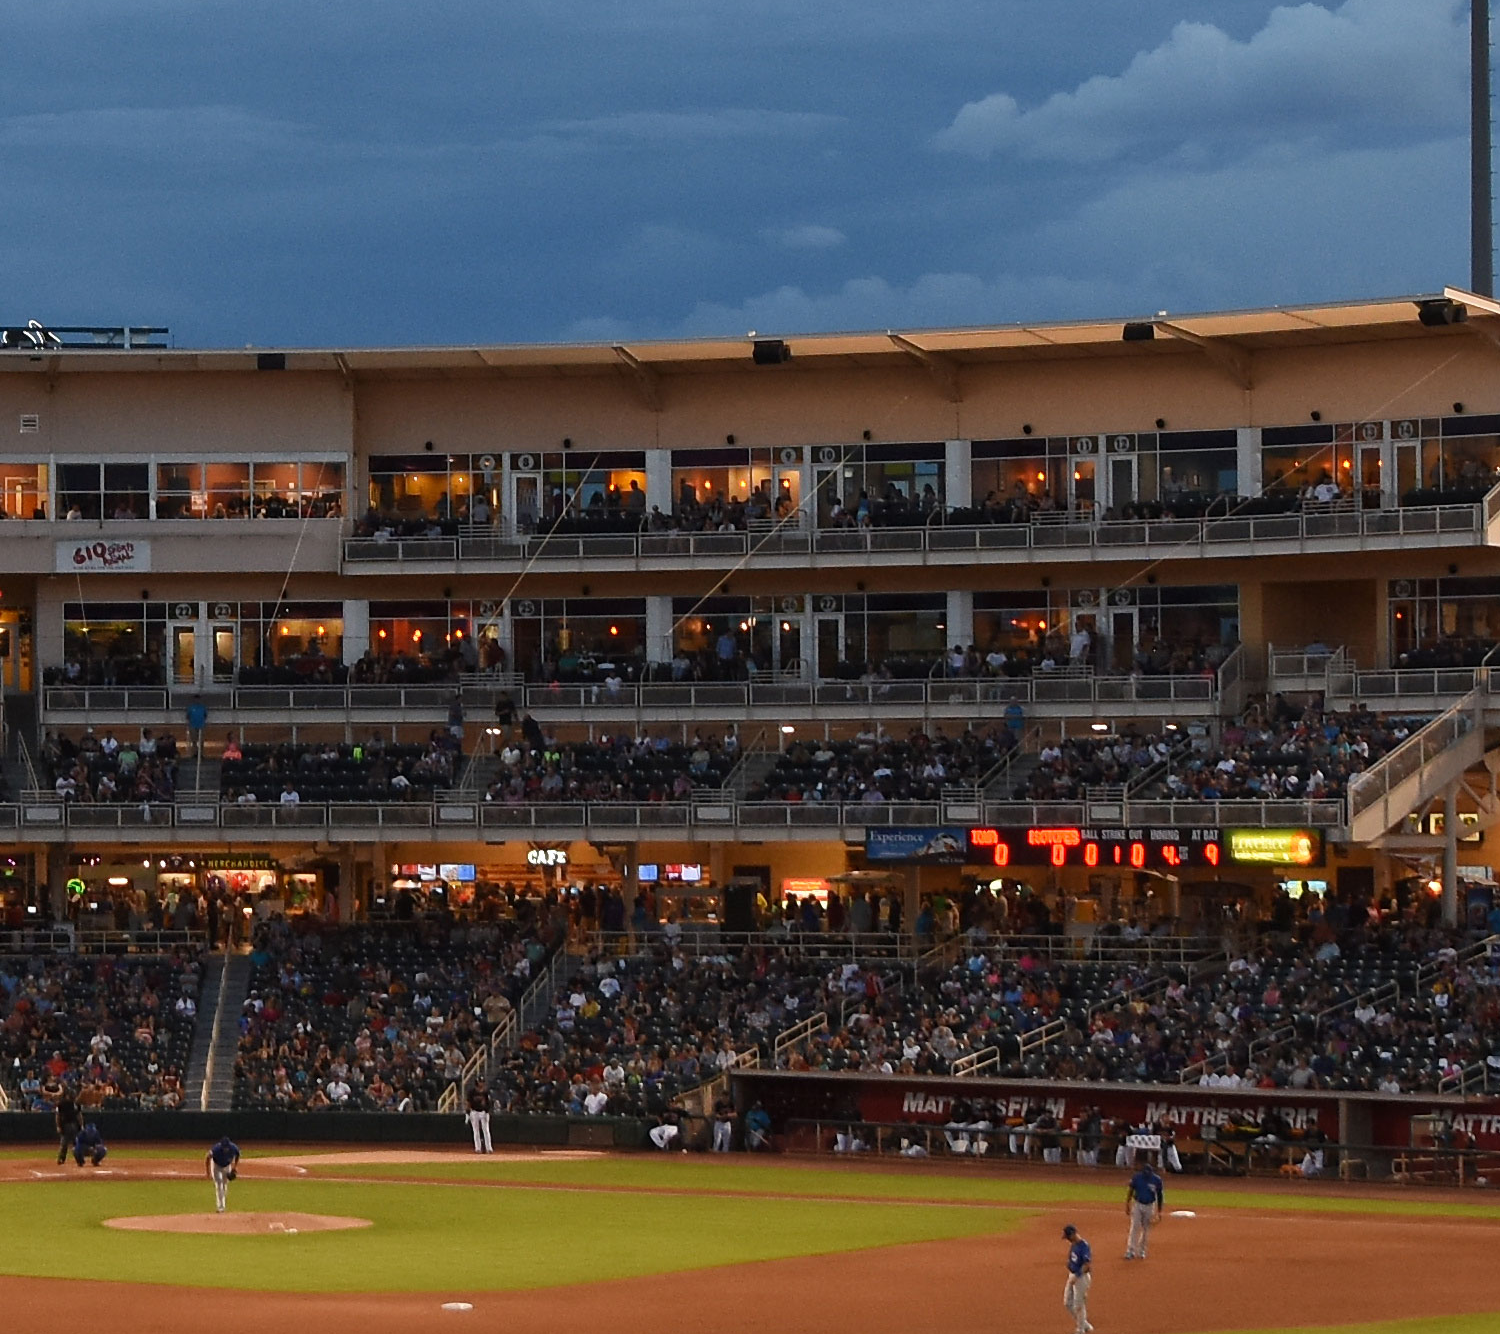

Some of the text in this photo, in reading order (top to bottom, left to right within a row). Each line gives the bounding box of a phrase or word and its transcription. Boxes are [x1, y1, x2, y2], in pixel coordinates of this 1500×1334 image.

[1116, 439, 1127, 450] 12
[822, 449, 833, 461] 10
[178, 605, 189, 616] 22
[217, 605, 228, 616] 23
[869, 830, 925, 844] Experience
[1081, 829, 1099, 840] BALL
[1101, 829, 1126, 840] STRIKE
[1128, 829, 1143, 840] OUT
[1203, 829, 1219, 840] BAT
[527, 849, 567, 866] CAFE
[994, 843, 1009, 866] 0
[1051, 843, 1066, 866] 0
[1084, 843, 1098, 866] 0
[1113, 845, 1121, 864] 1
[1131, 843, 1144, 867] 0
[1204, 843, 1219, 865] 9
[207, 859, 269, 868] MERCHANDISE
